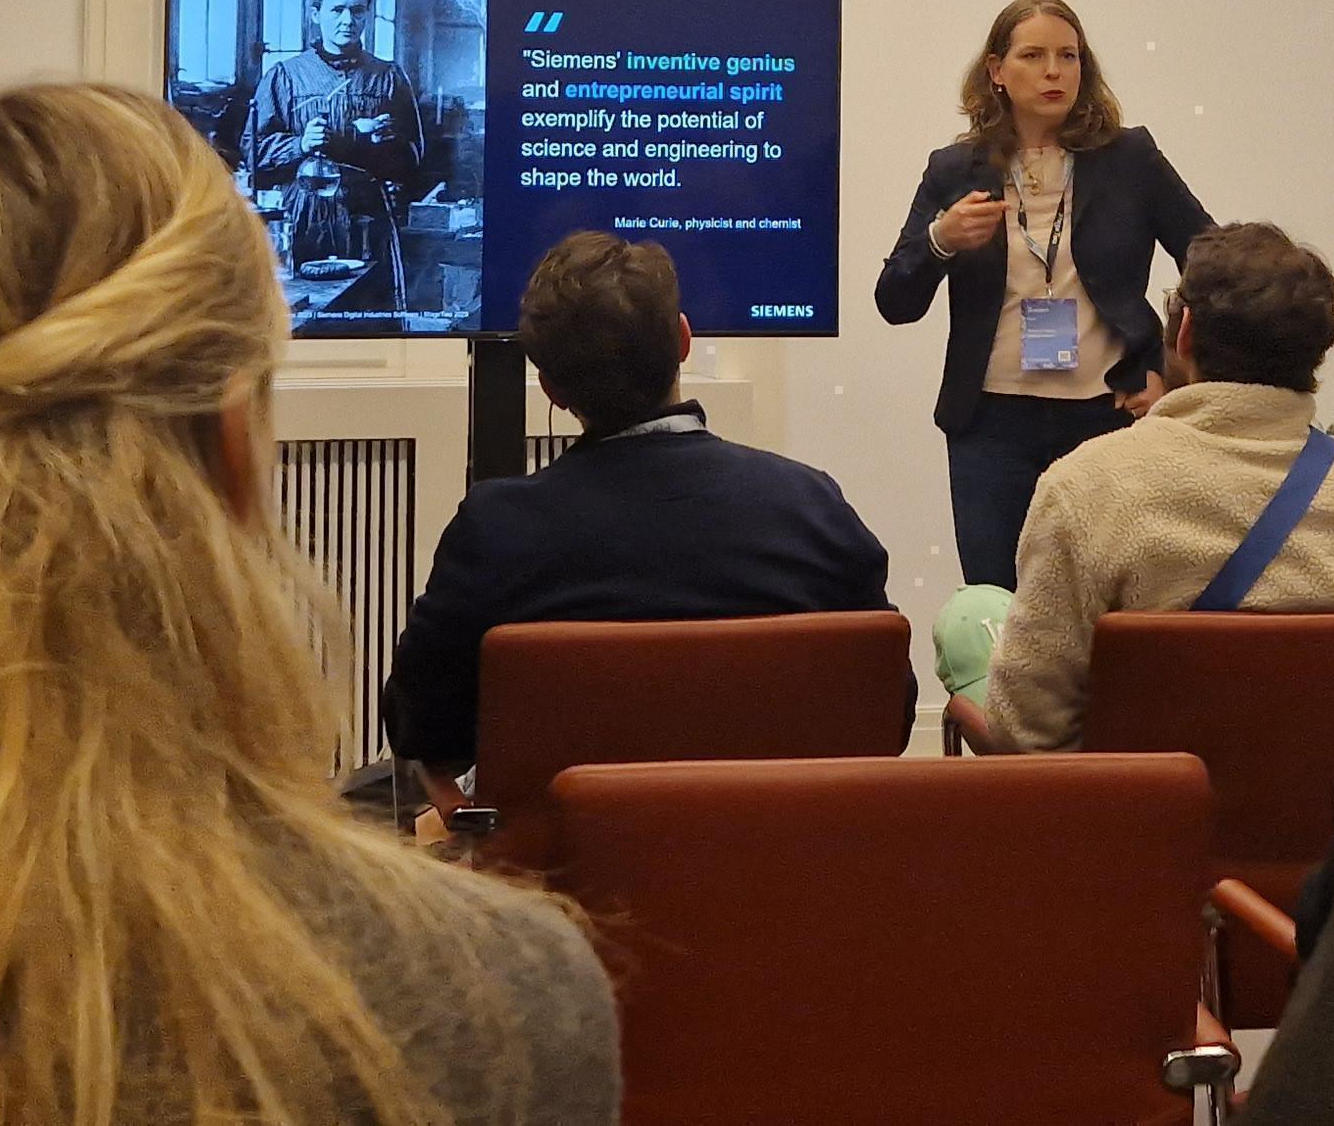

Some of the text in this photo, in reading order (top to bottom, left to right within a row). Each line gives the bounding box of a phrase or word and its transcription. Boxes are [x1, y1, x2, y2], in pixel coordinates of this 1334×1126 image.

[627, 52, 720, 71] inventive
[727, 54, 795, 75] genius
[522, 80, 784, 105] and entrepreneurial spirit
[521, 109, 765, 133] exemplify the potential of
[521, 138, 782, 162] science and engineering to
[520, 169, 682, 190] shape the world.
[615, 217, 802, 231] Marie Curie, physicist and chemist
[751, 305, 813, 317] SIEMENS
